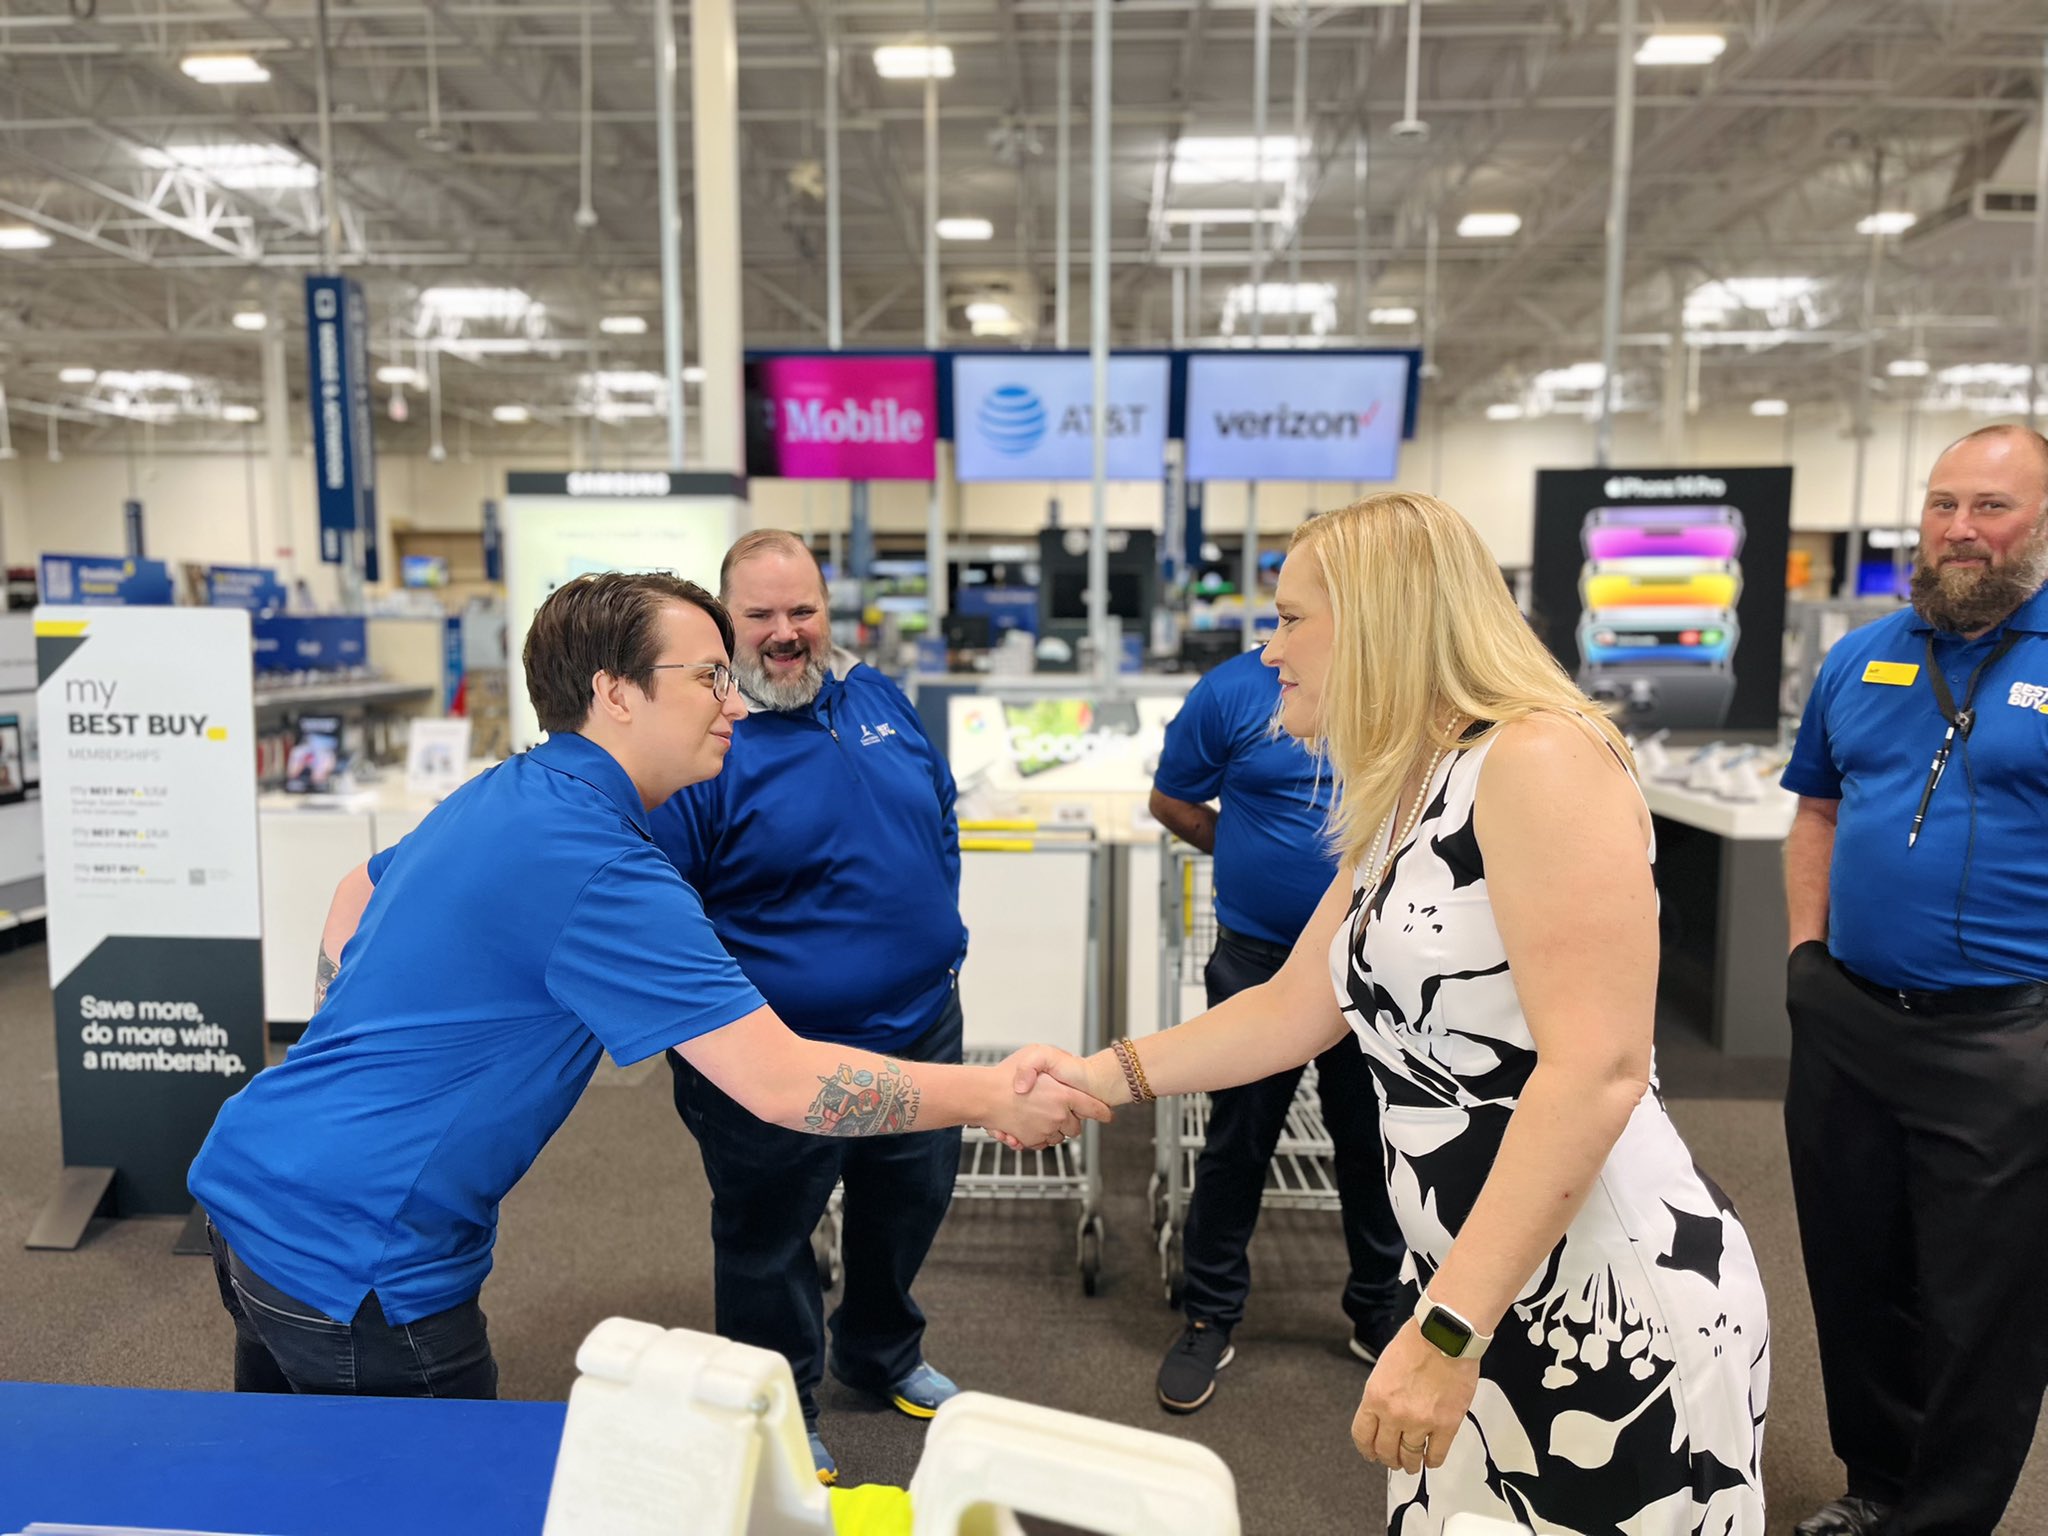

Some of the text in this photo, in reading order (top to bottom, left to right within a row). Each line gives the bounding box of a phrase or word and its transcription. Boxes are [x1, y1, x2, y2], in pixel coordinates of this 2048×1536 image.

[785, 398, 924, 443] Mobile
[1213, 402, 1360, 440] verizon
[66, 679, 117, 709] my
[2007, 693, 2047, 710] BUY
[68, 713, 208, 736] BEST BUY
[68, 747, 161, 762] MEMBERSHIPS
[1004, 727, 1131, 768] Goog
[80, 995, 204, 1023] Save more,
[81, 1021, 228, 1047] do more with
[83, 1048, 246, 1077] a membership.
